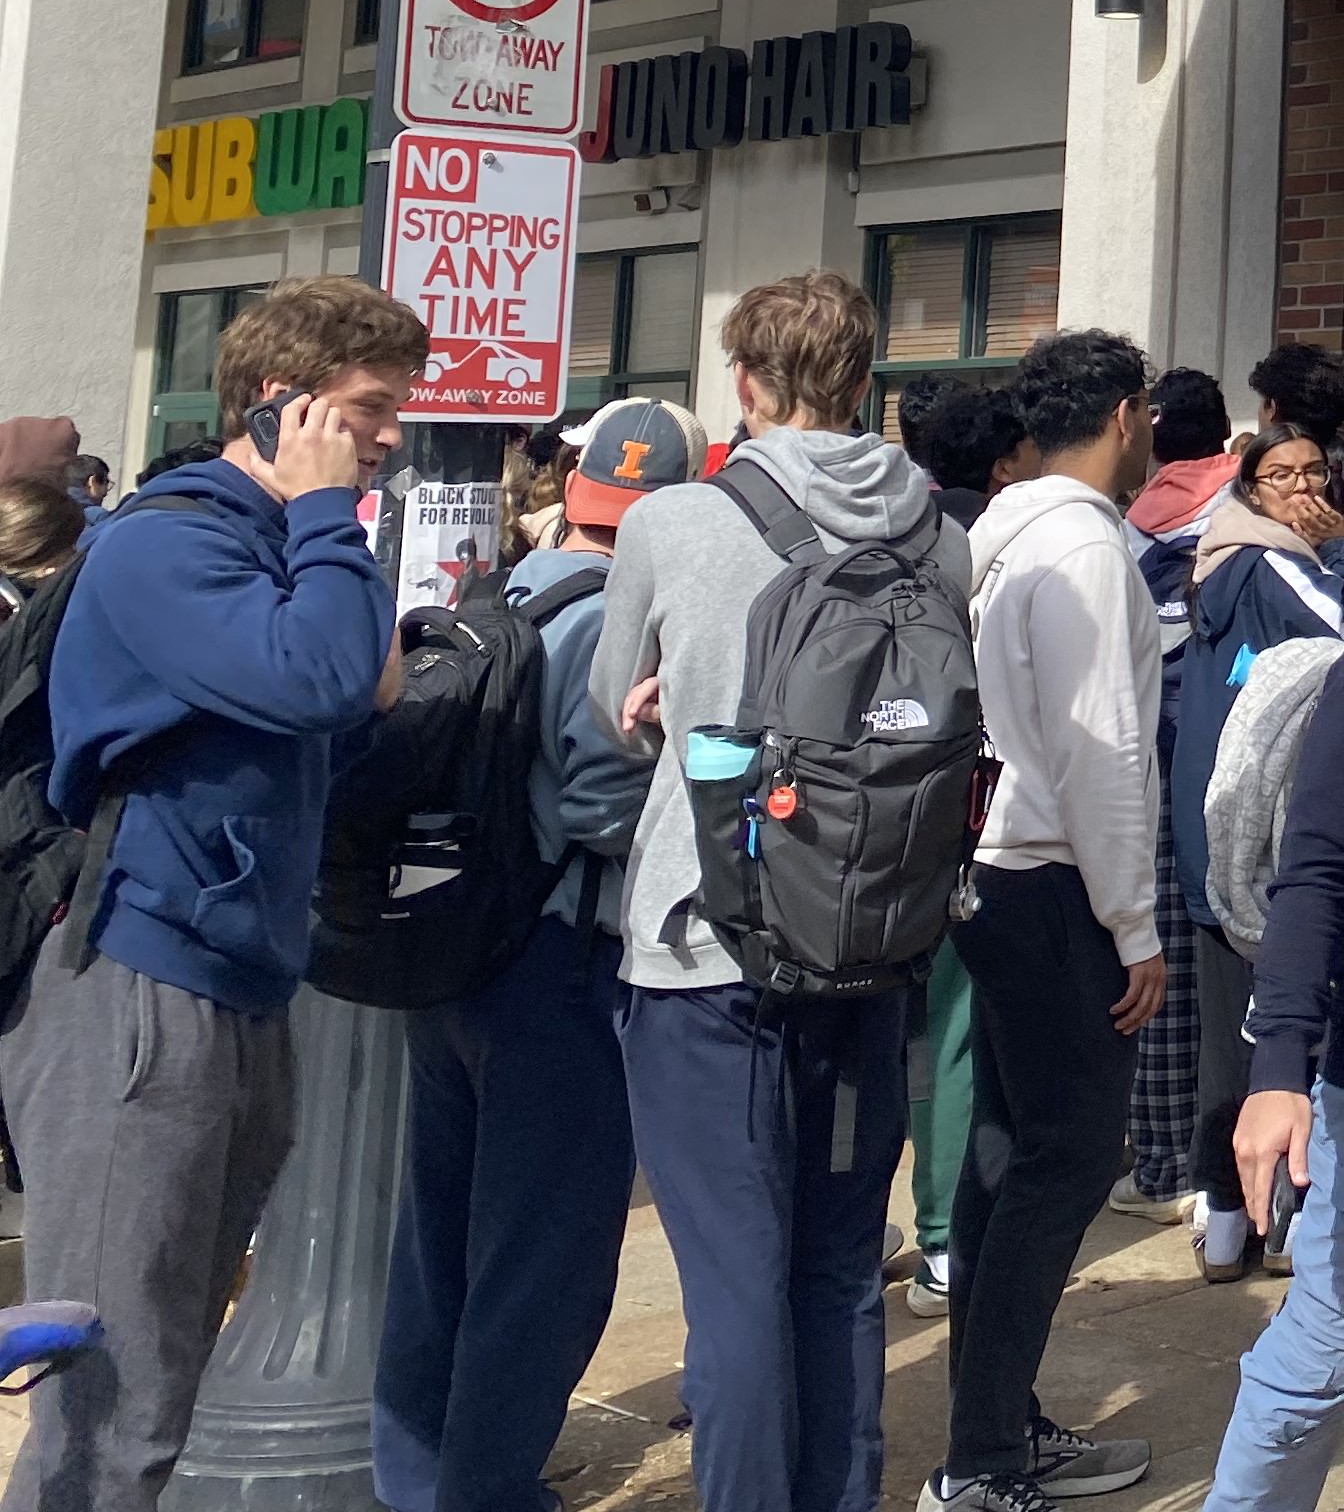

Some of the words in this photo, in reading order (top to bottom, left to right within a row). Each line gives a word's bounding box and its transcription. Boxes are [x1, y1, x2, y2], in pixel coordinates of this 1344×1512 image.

[451, 76, 534, 115] ZONE
[580, 46, 748, 163] JUNO
[750, 21, 912, 140] HAIR
[404, 144, 471, 193] NO
[402, 207, 561, 251] STOPPING
[422, 245, 538, 292] ANY
[418, 294, 527, 338] TIME
[496, 390, 546, 406] ZONE
[418, 487, 465, 505] BLACK
[418, 507, 448, 525] FOR
[860, 710, 906, 724] NORTH
[879, 699, 906, 711] THE
[873, 719, 906, 733] FACE
